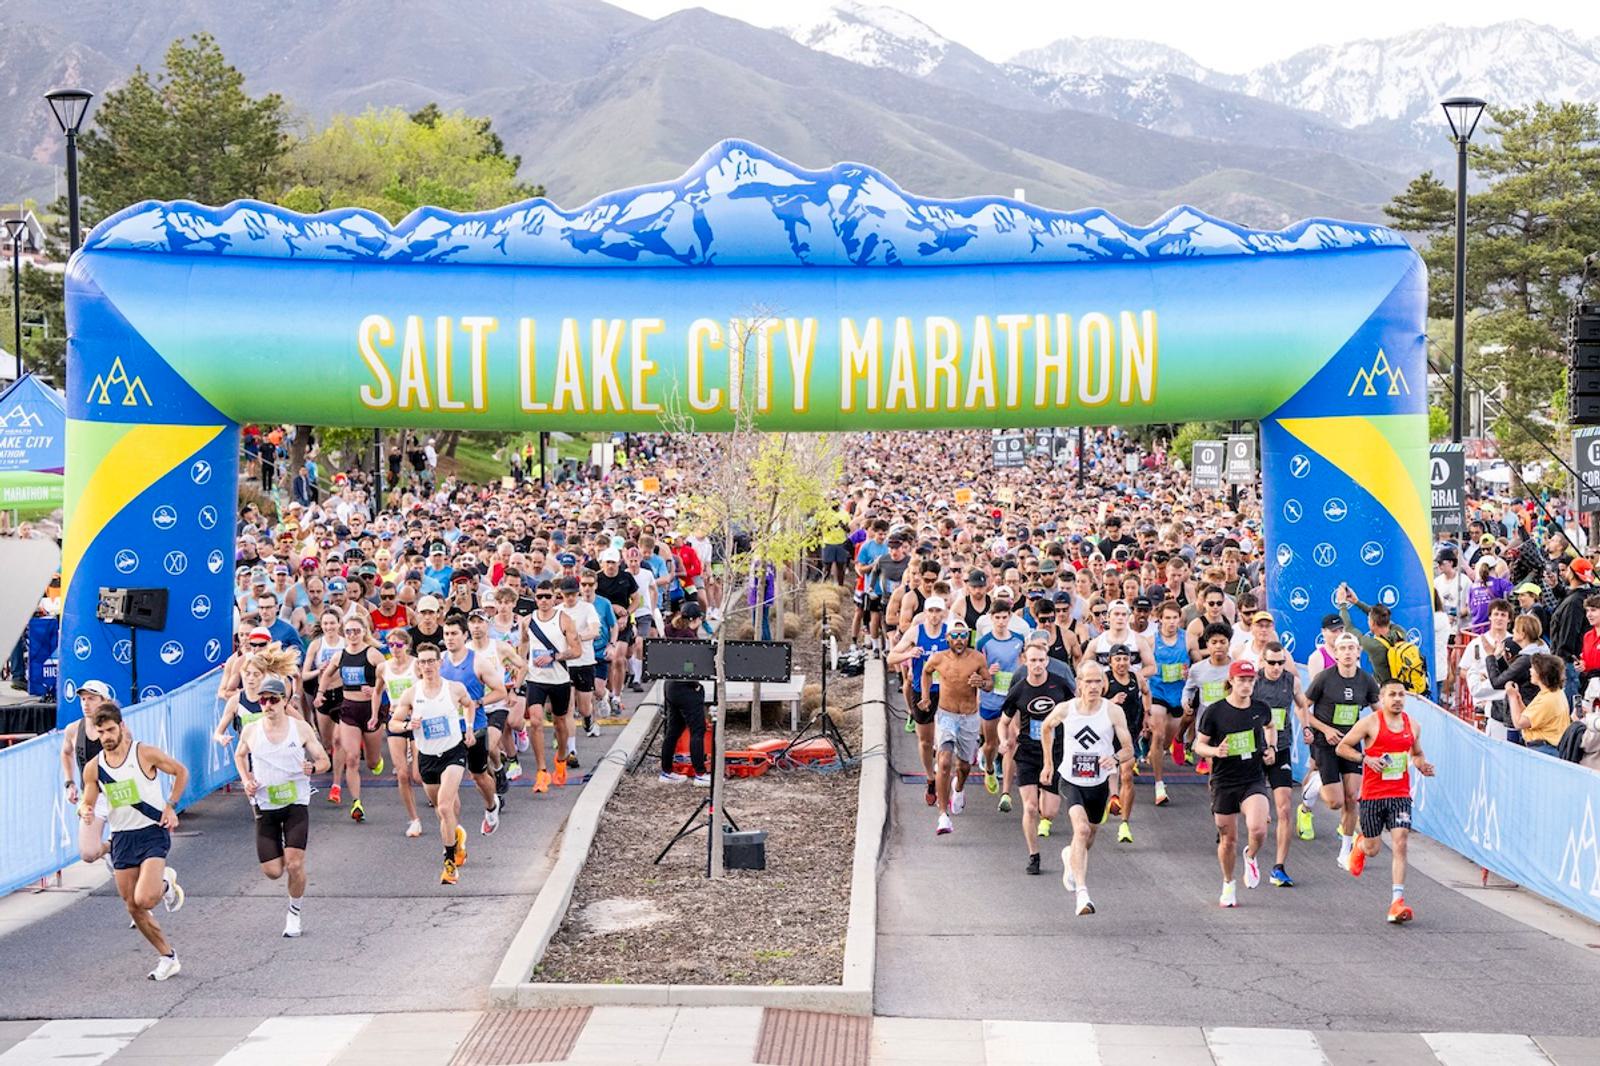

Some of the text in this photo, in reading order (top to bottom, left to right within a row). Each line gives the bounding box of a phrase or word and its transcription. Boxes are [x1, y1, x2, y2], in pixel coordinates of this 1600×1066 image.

[358, 309, 1159, 414] SALT LAKE CITY MARATHON
[25, 436, 54, 449] CITY
[1431, 462, 1444, 481] A
[112, 787, 132, 801] 3117
